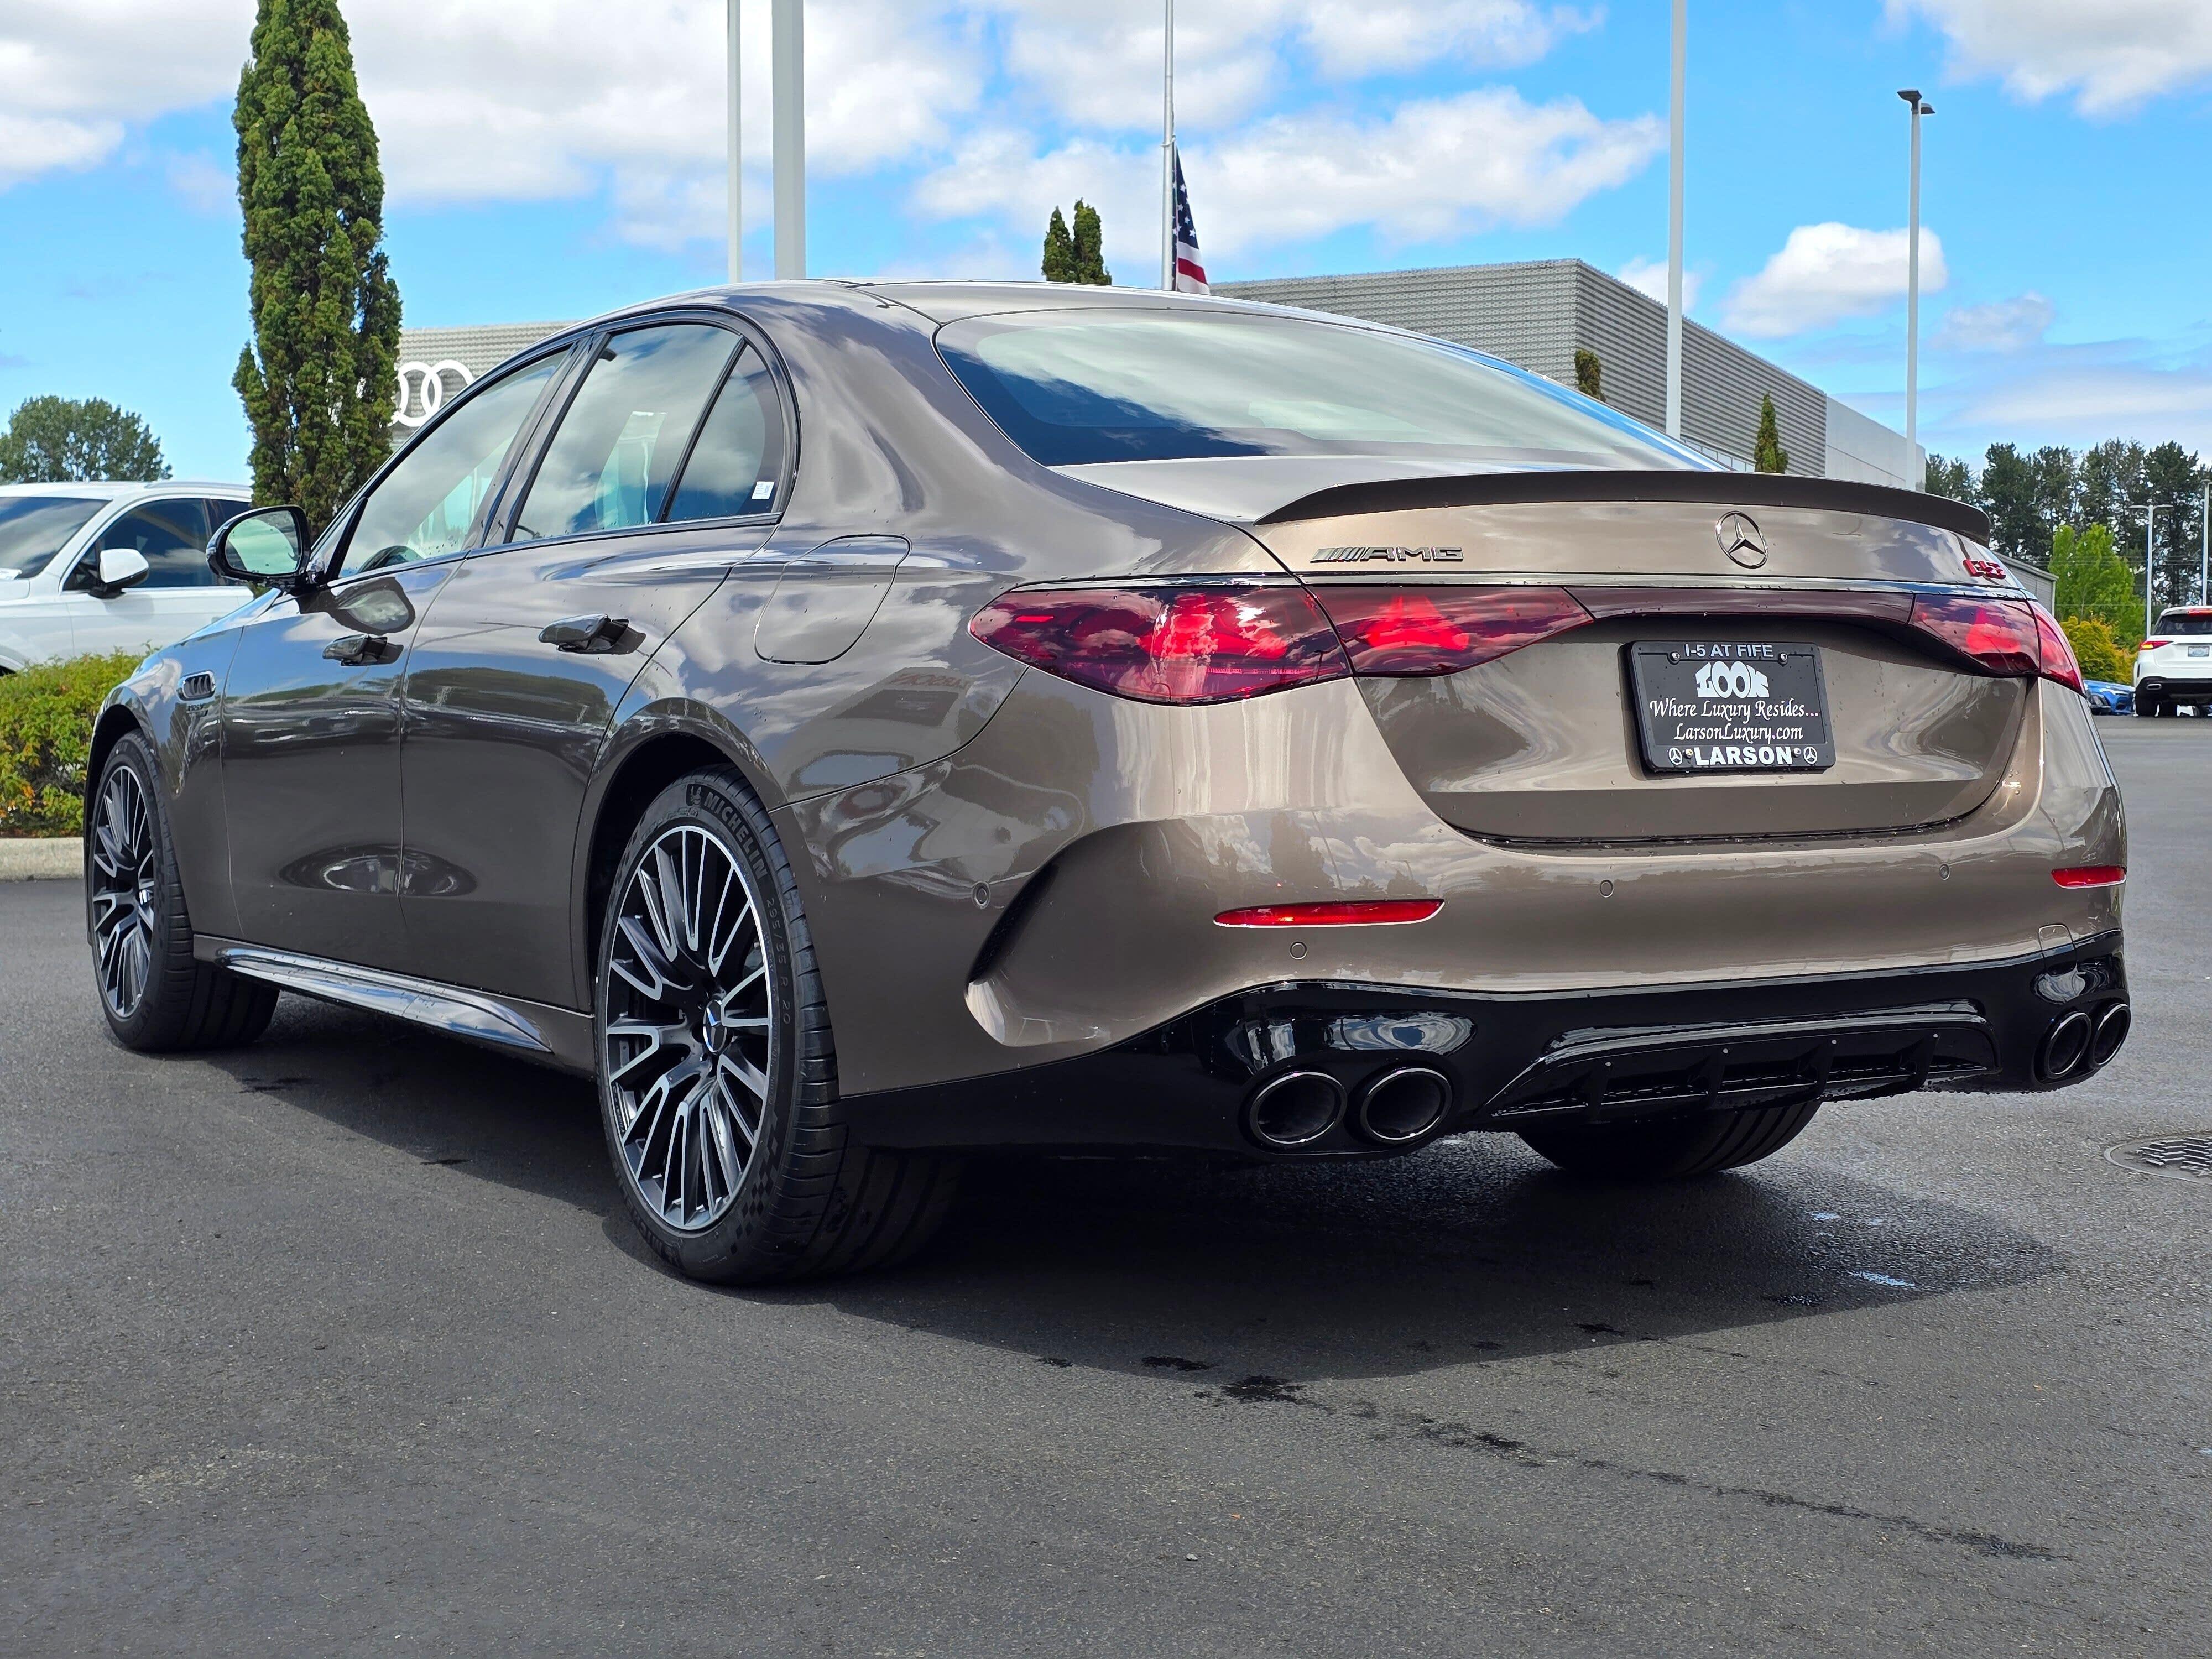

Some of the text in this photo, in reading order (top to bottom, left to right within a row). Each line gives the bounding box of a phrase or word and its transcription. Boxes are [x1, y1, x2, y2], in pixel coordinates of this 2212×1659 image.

[1359, 546, 1464, 562] AMG
[1684, 644, 1774, 658] I-5 AT FIFE
[1695, 661, 1770, 698] LOOK
[1650, 697, 1819, 724] Where Luxury Resides...
[1673, 723, 1803, 744] LarsonLuxury.com
[1693, 746, 1793, 765] LARSON
[703, 791, 768, 879] MICHELIN
[766, 898, 786, 964] 295/35
[782, 1000, 791, 1024] 20
